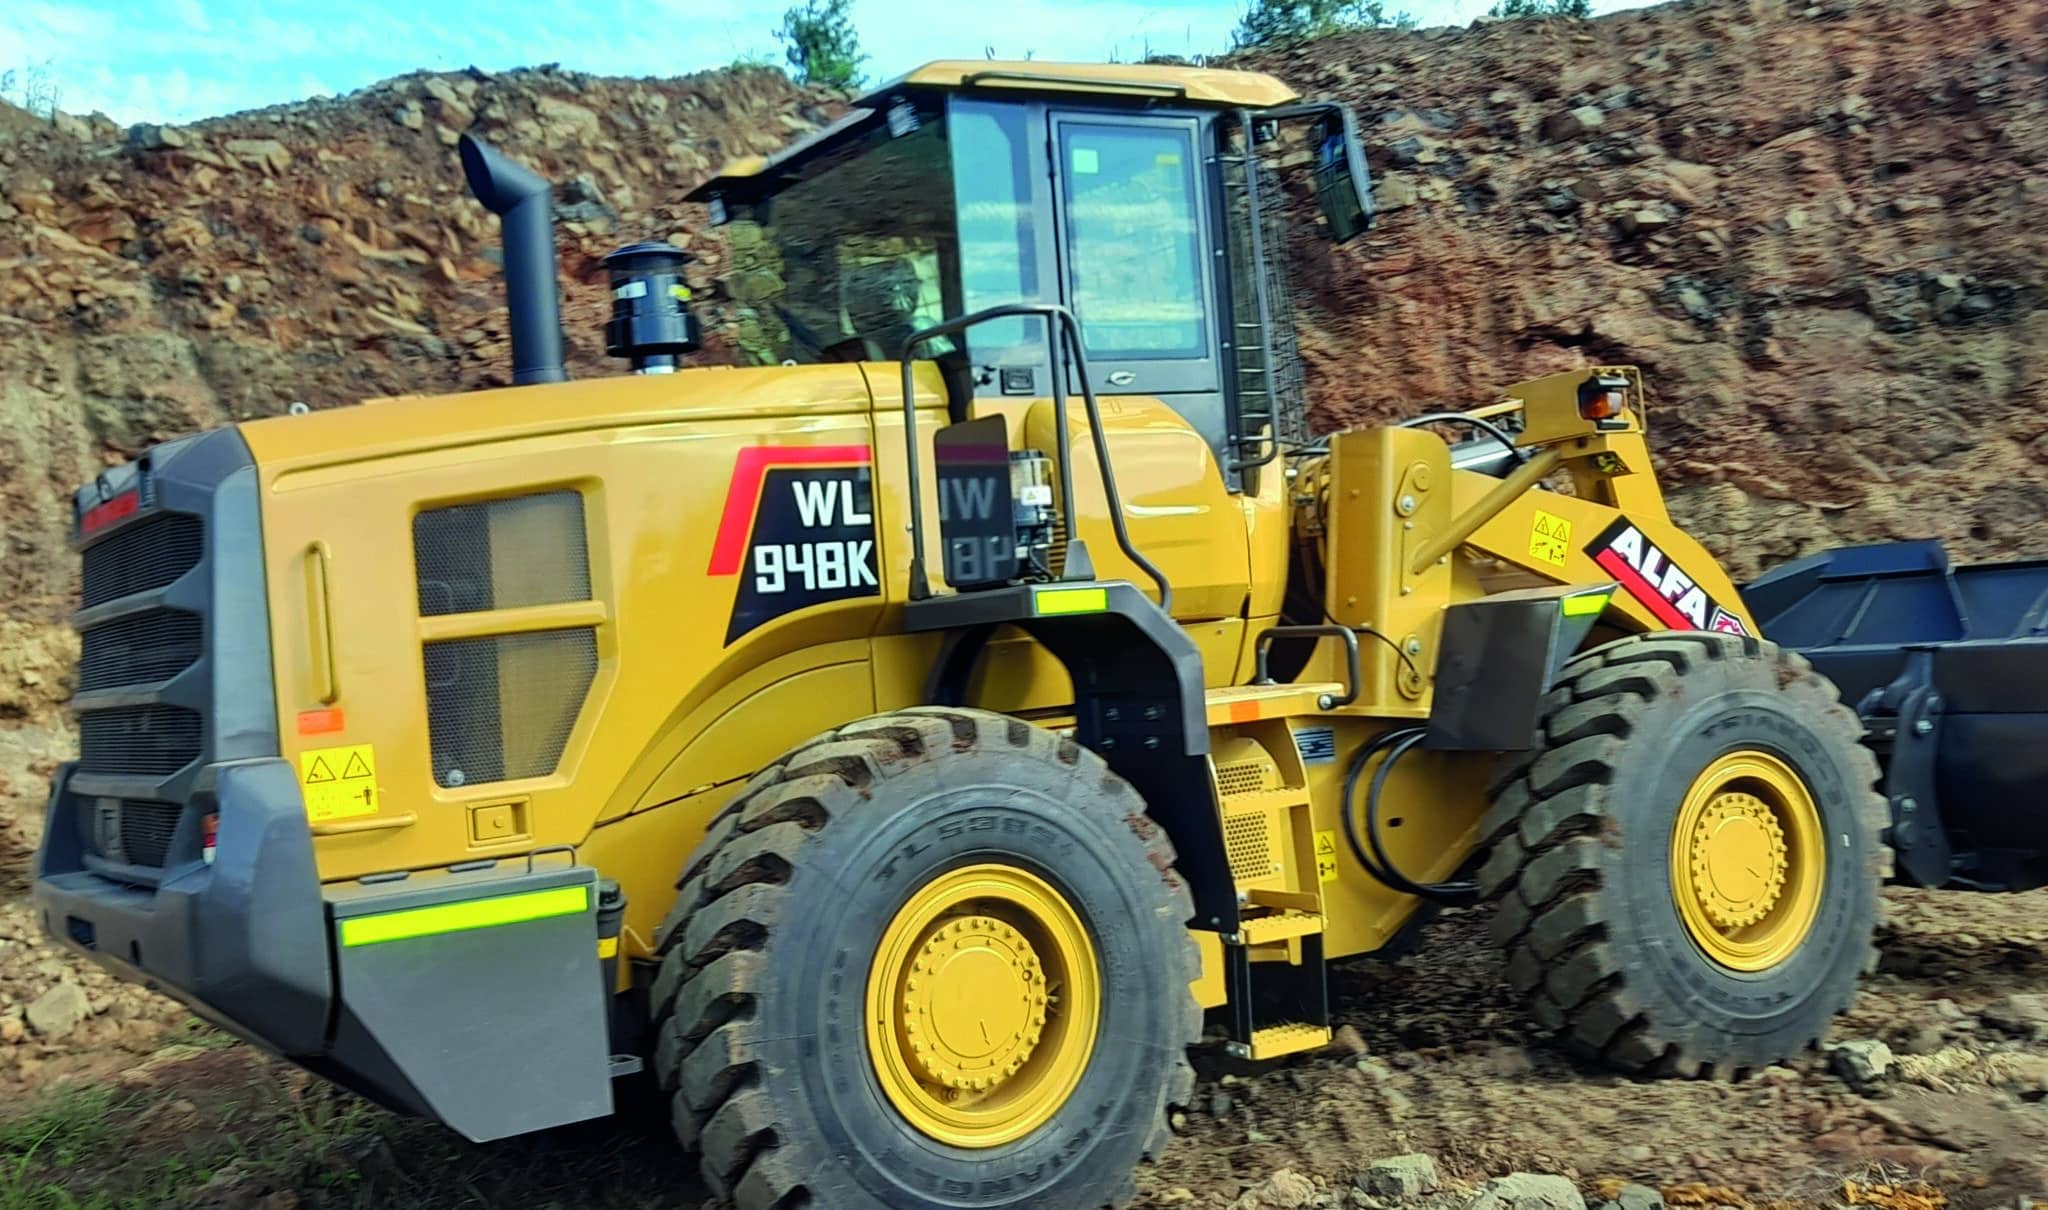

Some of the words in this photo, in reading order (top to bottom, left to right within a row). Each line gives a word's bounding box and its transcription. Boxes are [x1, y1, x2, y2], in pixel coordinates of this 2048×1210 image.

[792, 480, 871, 527] WL
[754, 540, 878, 593] 948K
[1609, 525, 1707, 630] ALFA
